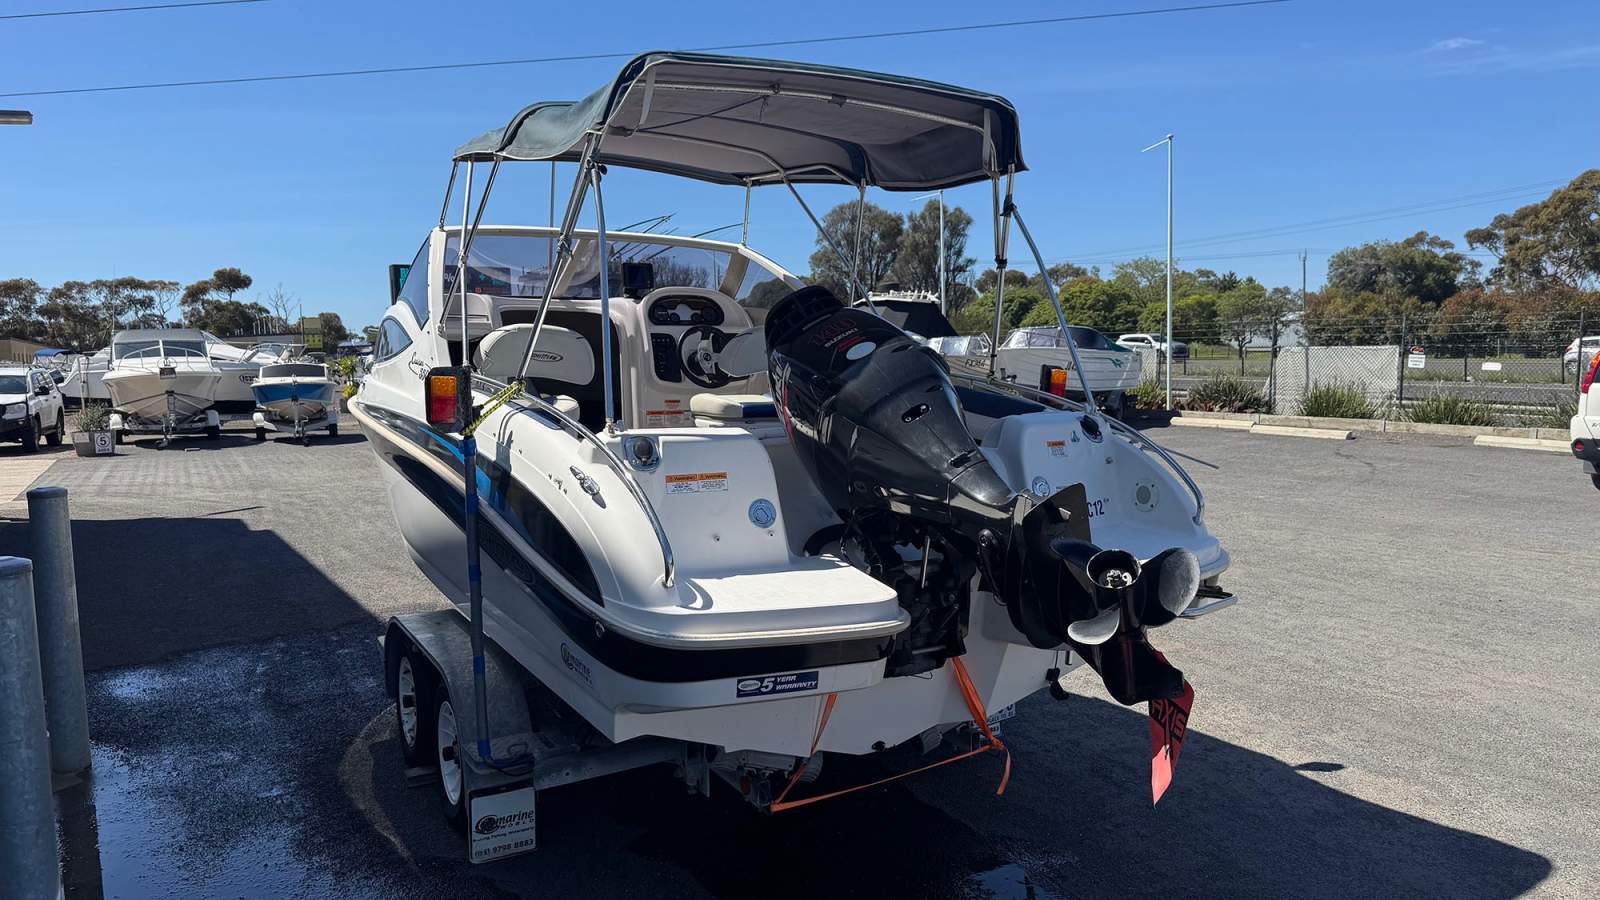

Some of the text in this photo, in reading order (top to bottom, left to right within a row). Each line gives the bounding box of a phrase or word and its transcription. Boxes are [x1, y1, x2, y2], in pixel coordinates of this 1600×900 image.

[99, 436, 107, 446] 5
[760, 677, 776, 692] 5
[777, 675, 797, 683] YEAR
[776, 680, 817, 691] WARRANTY
[496, 810, 534, 825] marine
